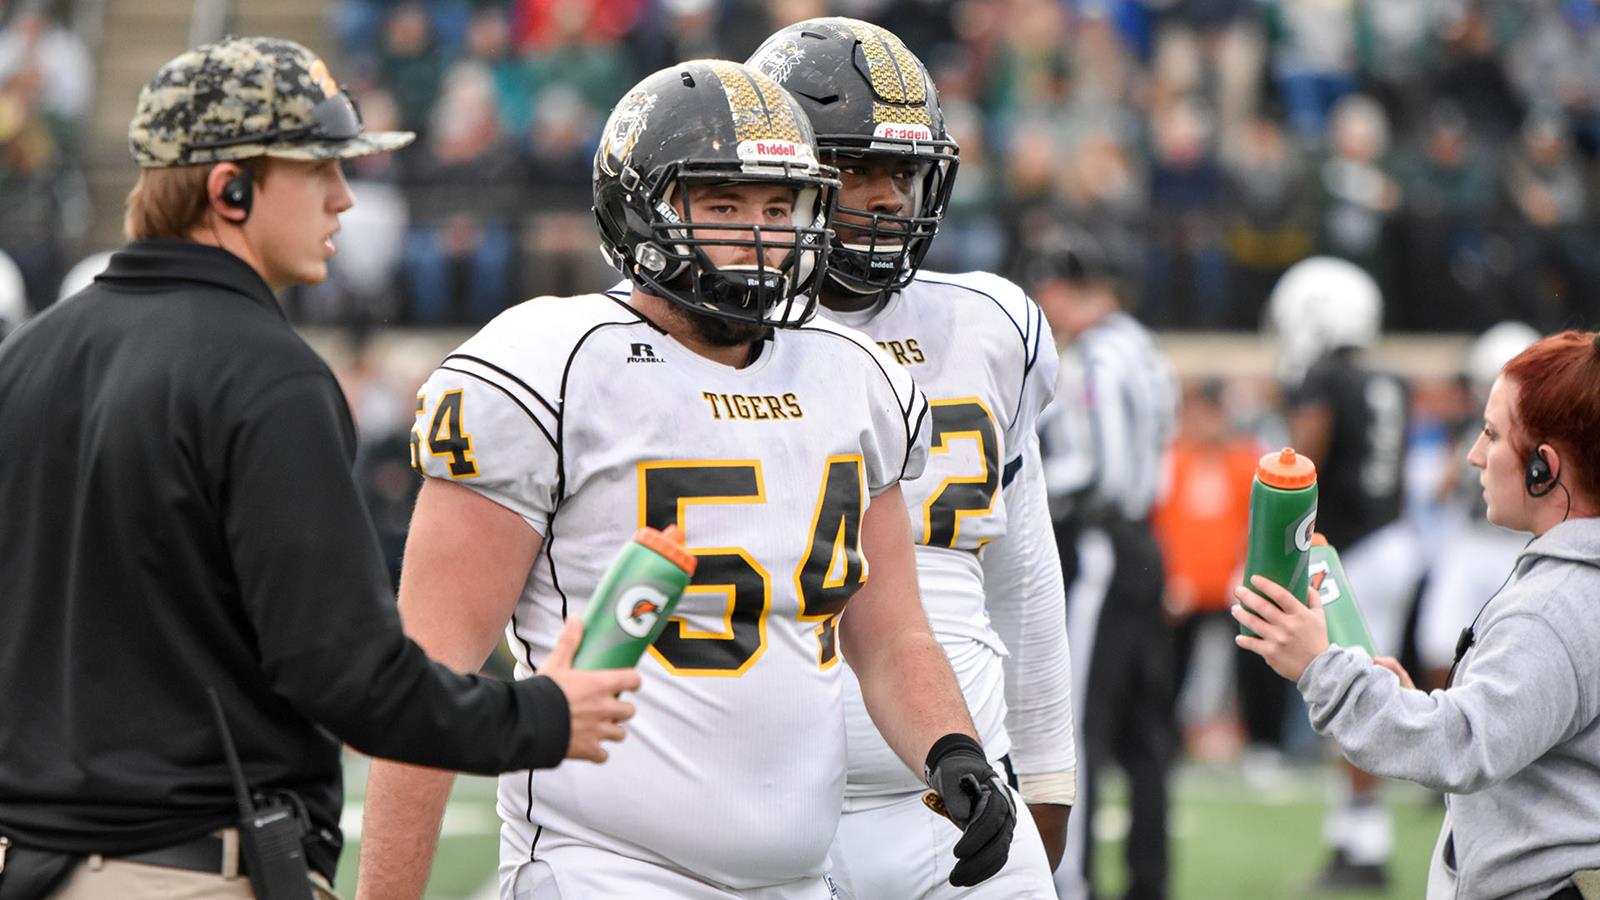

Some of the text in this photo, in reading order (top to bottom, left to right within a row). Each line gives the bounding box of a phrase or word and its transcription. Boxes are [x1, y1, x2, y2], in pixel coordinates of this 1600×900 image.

[885, 127, 929, 141] Riddell
[757, 143, 796, 156] Riddell
[747, 278, 775, 288] Riell
[626, 356, 667, 364] RUSSELL
[876, 339, 925, 365] RS
[702, 391, 804, 421] TIGERS
[637, 453, 868, 677] 54
[616, 585, 669, 638] G
